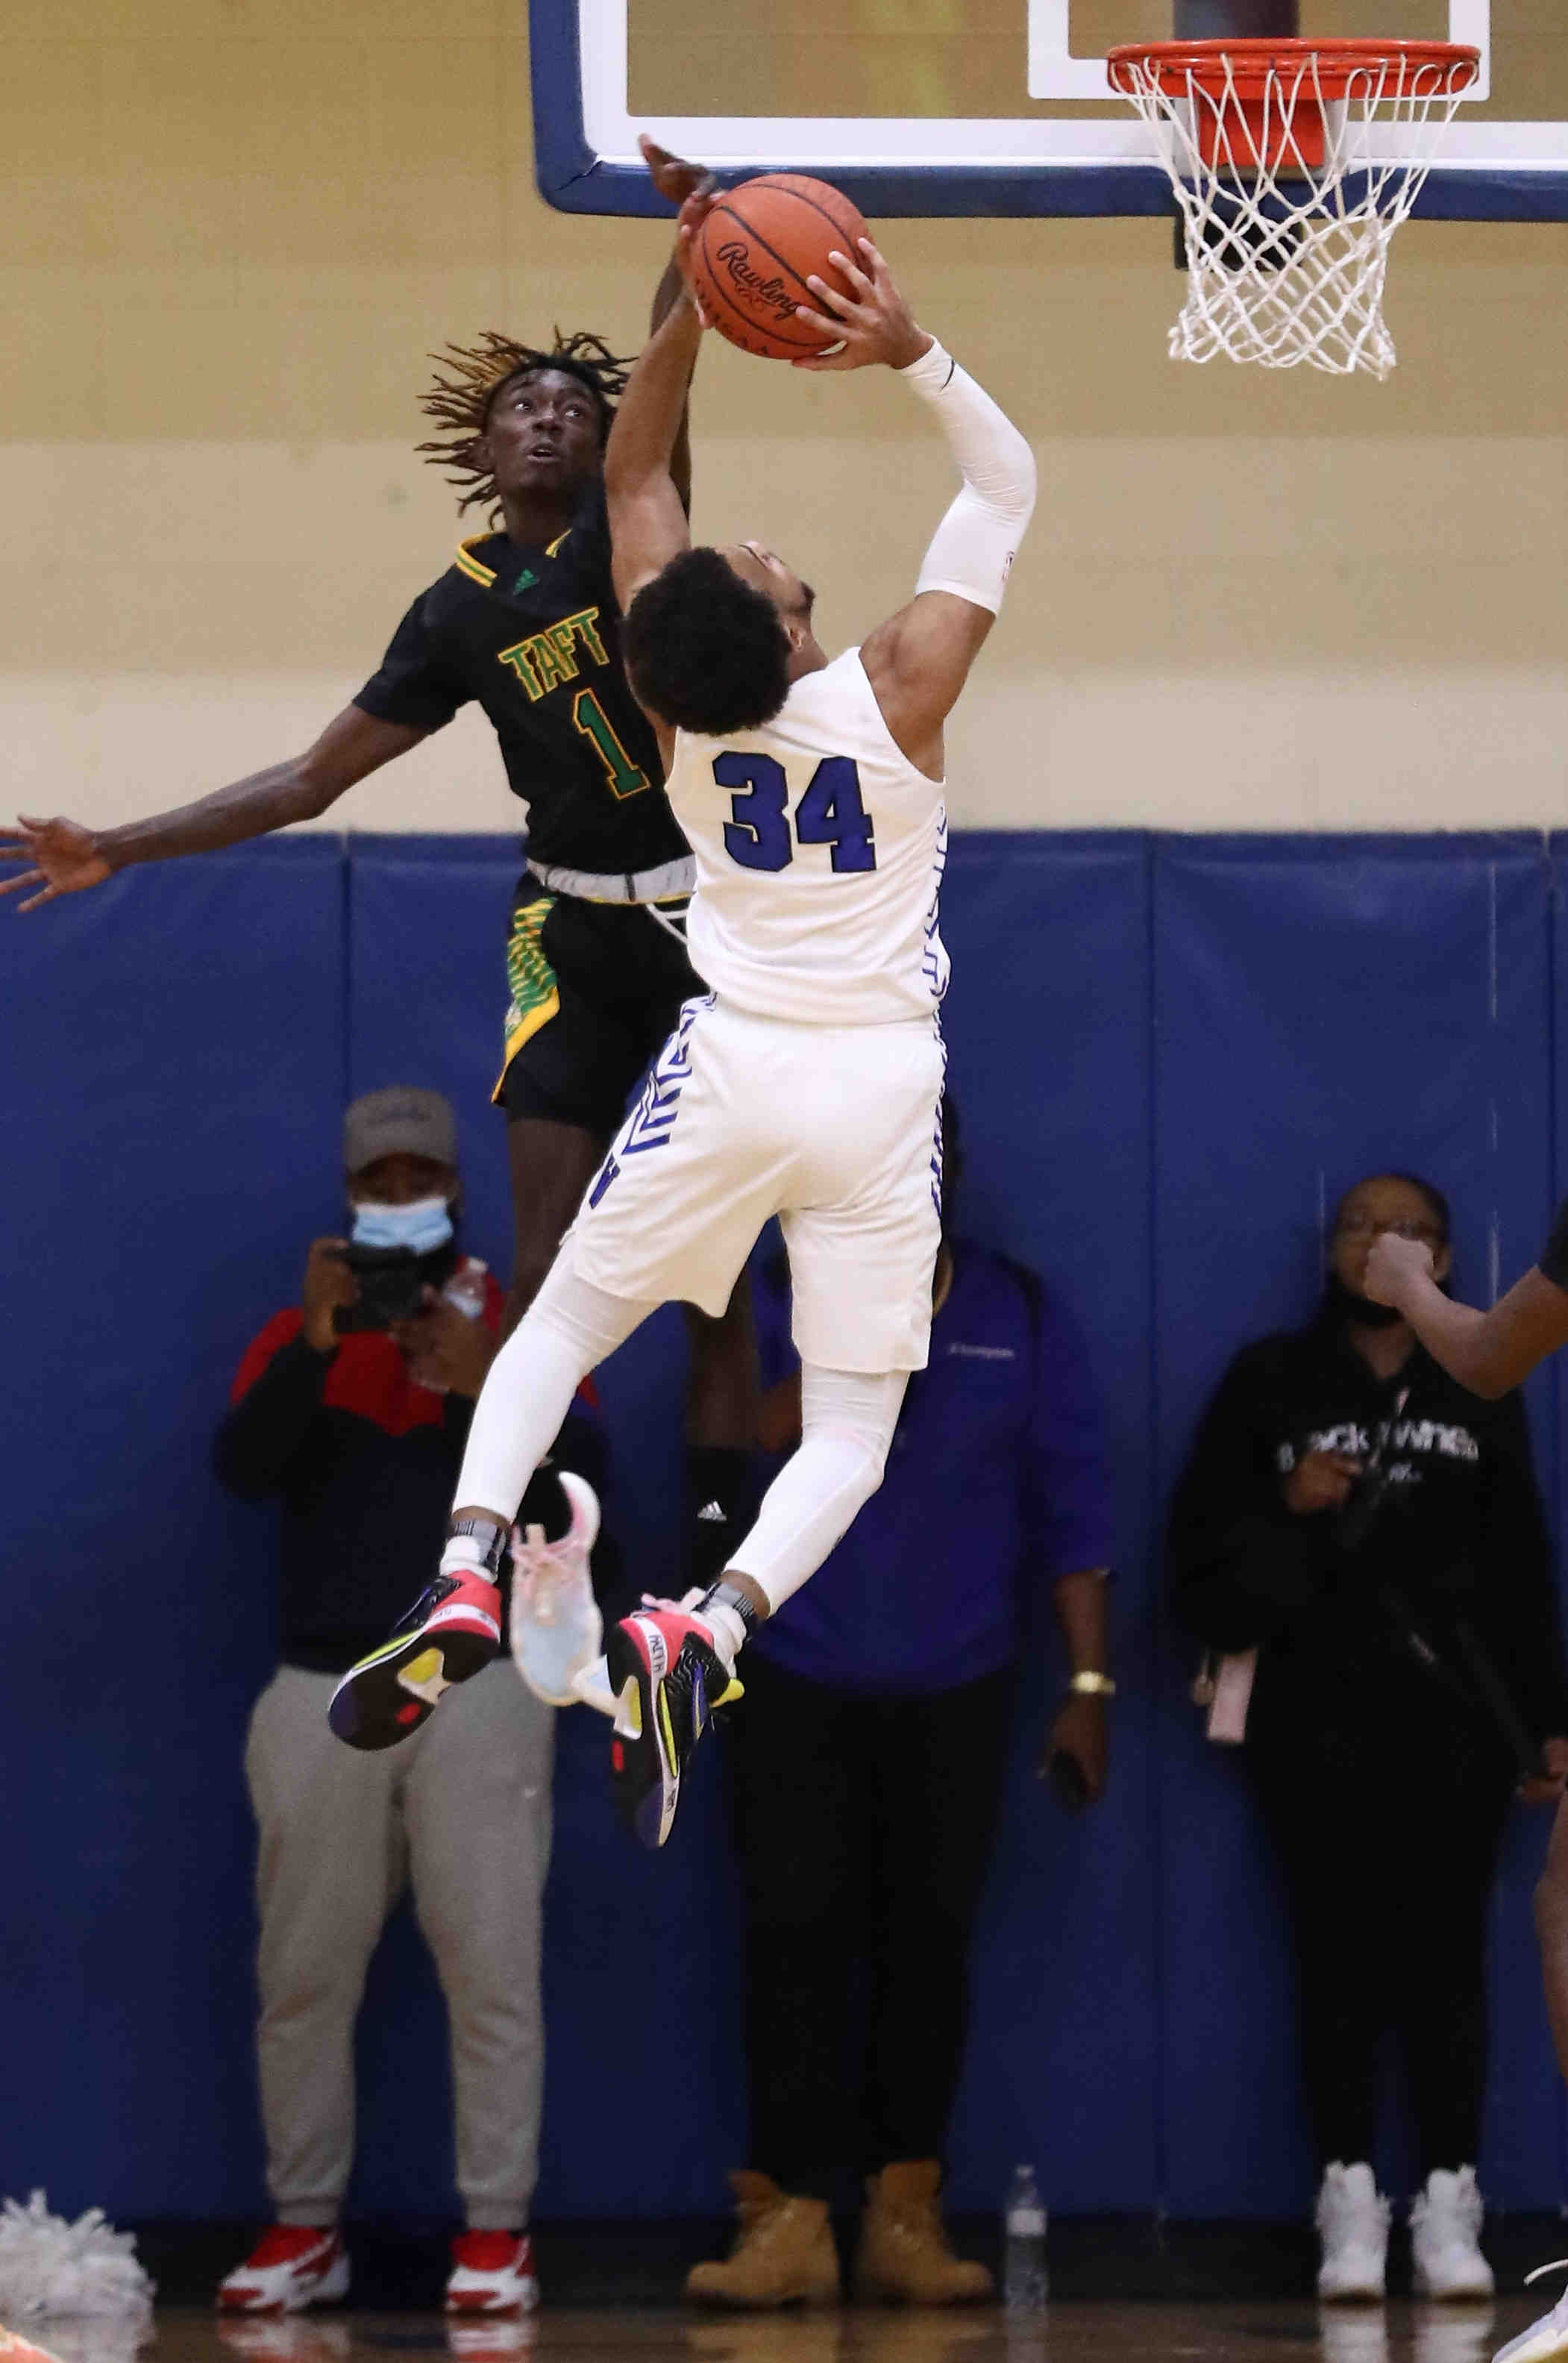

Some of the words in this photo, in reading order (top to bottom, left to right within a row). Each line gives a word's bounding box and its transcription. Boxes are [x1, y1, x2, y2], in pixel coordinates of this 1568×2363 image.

[716, 241, 800, 321] Rawling
[498, 606, 610, 702] TAFT
[573, 687, 651, 800] 1
[712, 750, 877, 874] 34
